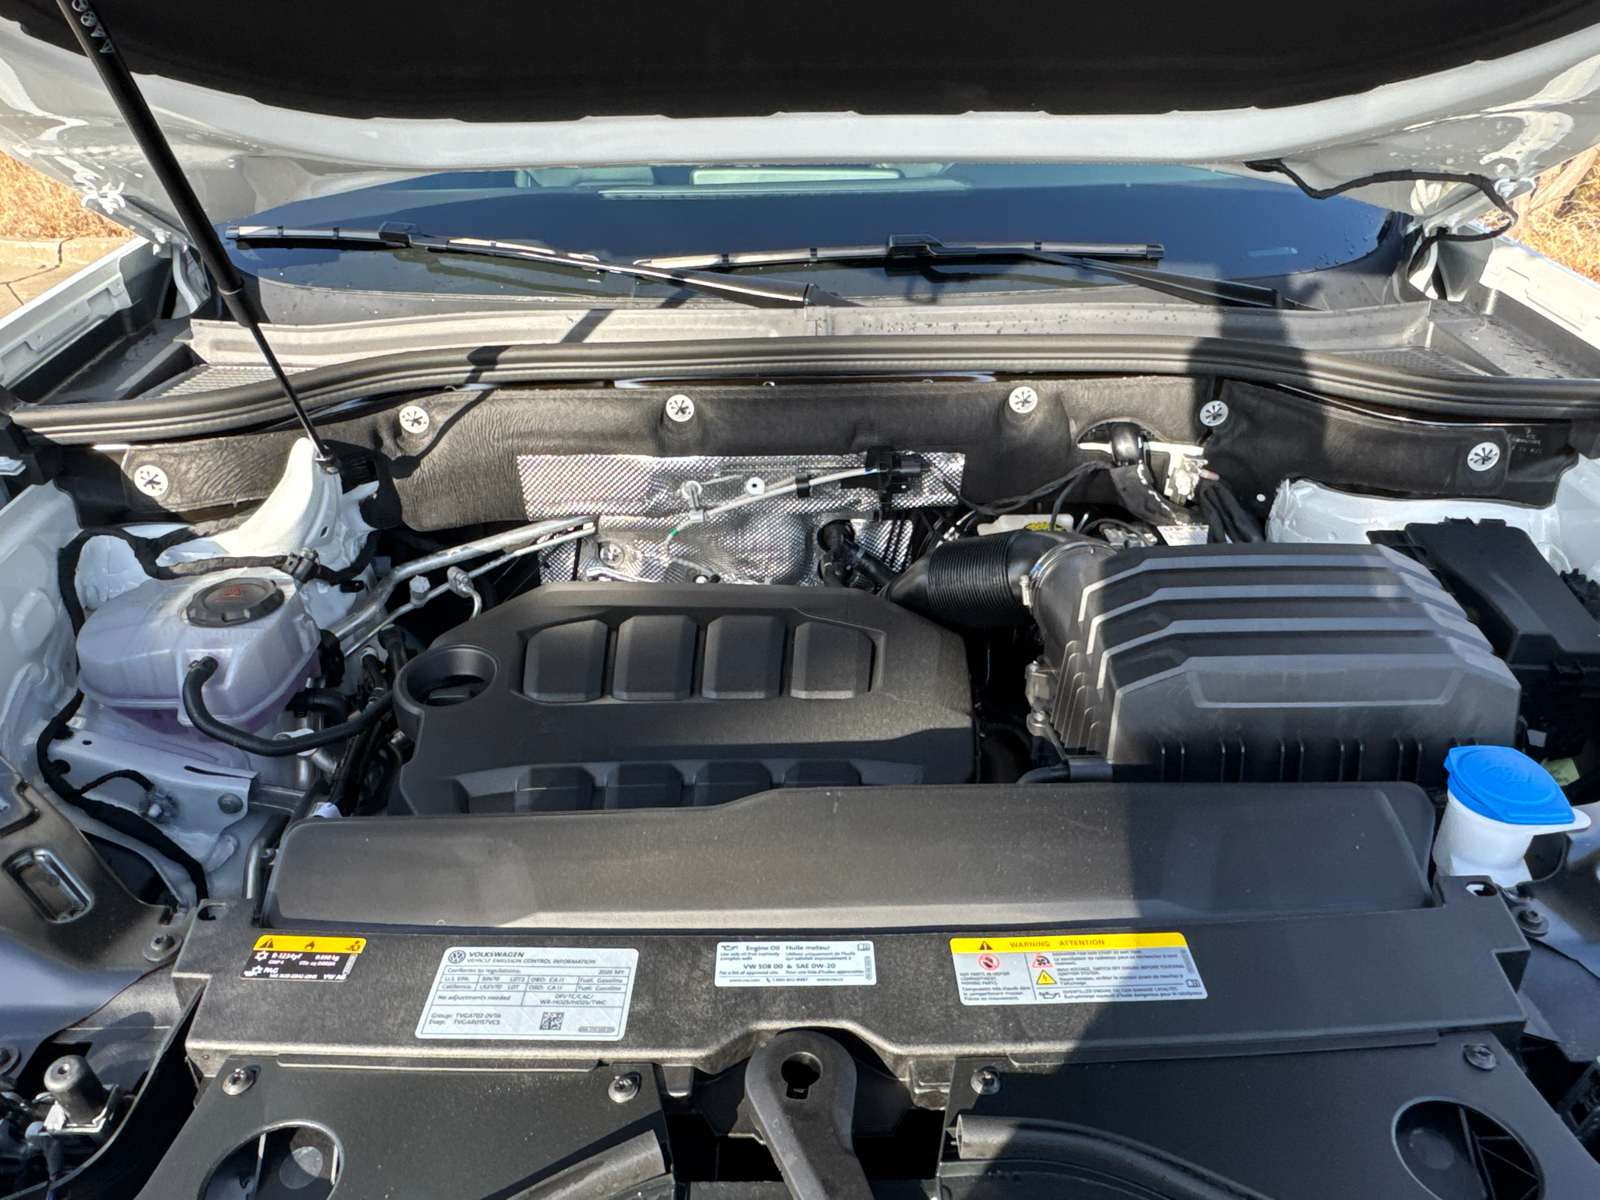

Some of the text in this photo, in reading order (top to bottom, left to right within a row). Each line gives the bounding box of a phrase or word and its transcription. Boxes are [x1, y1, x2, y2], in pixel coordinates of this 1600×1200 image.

[1009, 939, 1105, 948] WARNING ATTENTION
[263, 966, 279, 974] PAG
